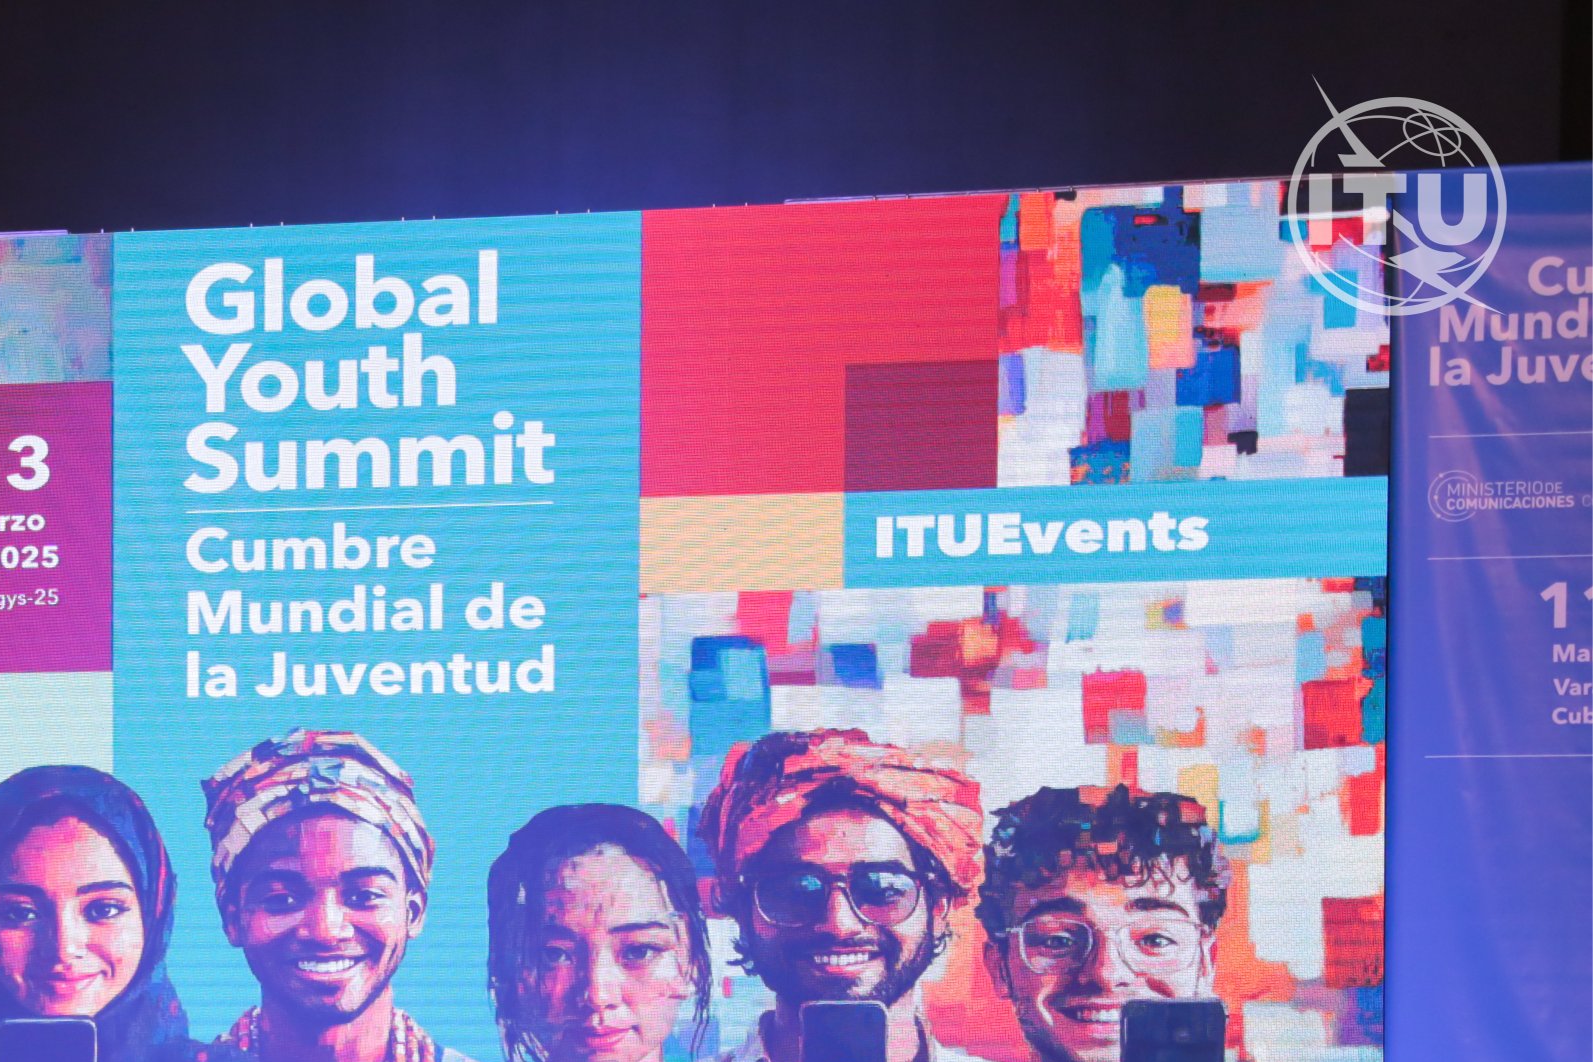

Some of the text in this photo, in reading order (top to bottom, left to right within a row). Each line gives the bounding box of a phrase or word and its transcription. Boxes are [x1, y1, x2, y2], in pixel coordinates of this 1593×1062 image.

[185, 249, 498, 335] Global
[180, 333, 457, 413] Youth
[1429, 346, 1471, 386] la
[183, 411, 555, 494] Summit
[1446, 495, 1575, 511] COMUNICACIONES
[186, 522, 436, 573] Cumbre
[876, 512, 1209, 558] ITUEvents
[187, 582, 545, 634] Mundial de
[1541, 582, 1592, 628] 1
[187, 644, 555, 698] la Juventud
